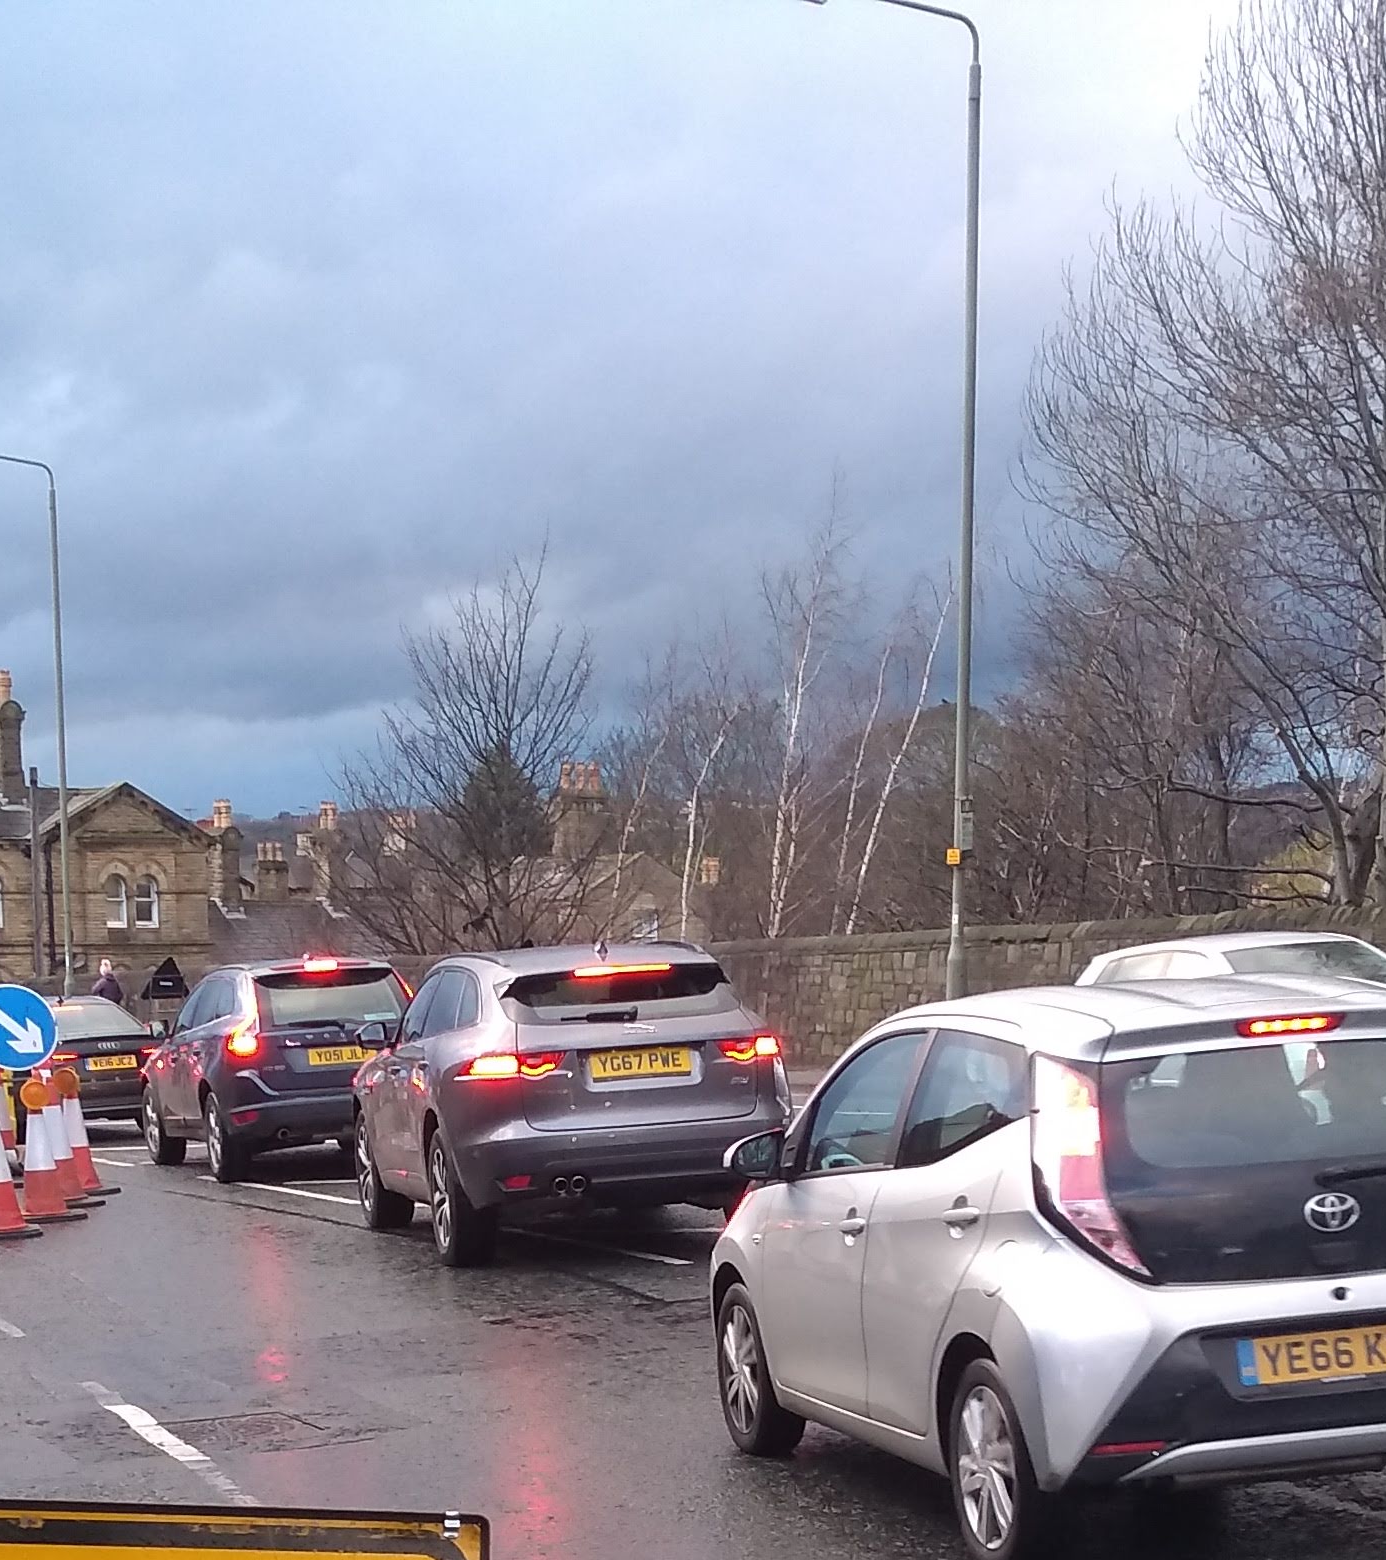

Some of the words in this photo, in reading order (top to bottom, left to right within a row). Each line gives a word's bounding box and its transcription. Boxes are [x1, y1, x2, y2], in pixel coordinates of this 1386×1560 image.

[597, 1054, 643, 1073] YG67
[648, 1050, 683, 1070] PWE
[1262, 1336, 1354, 1377] YE66
